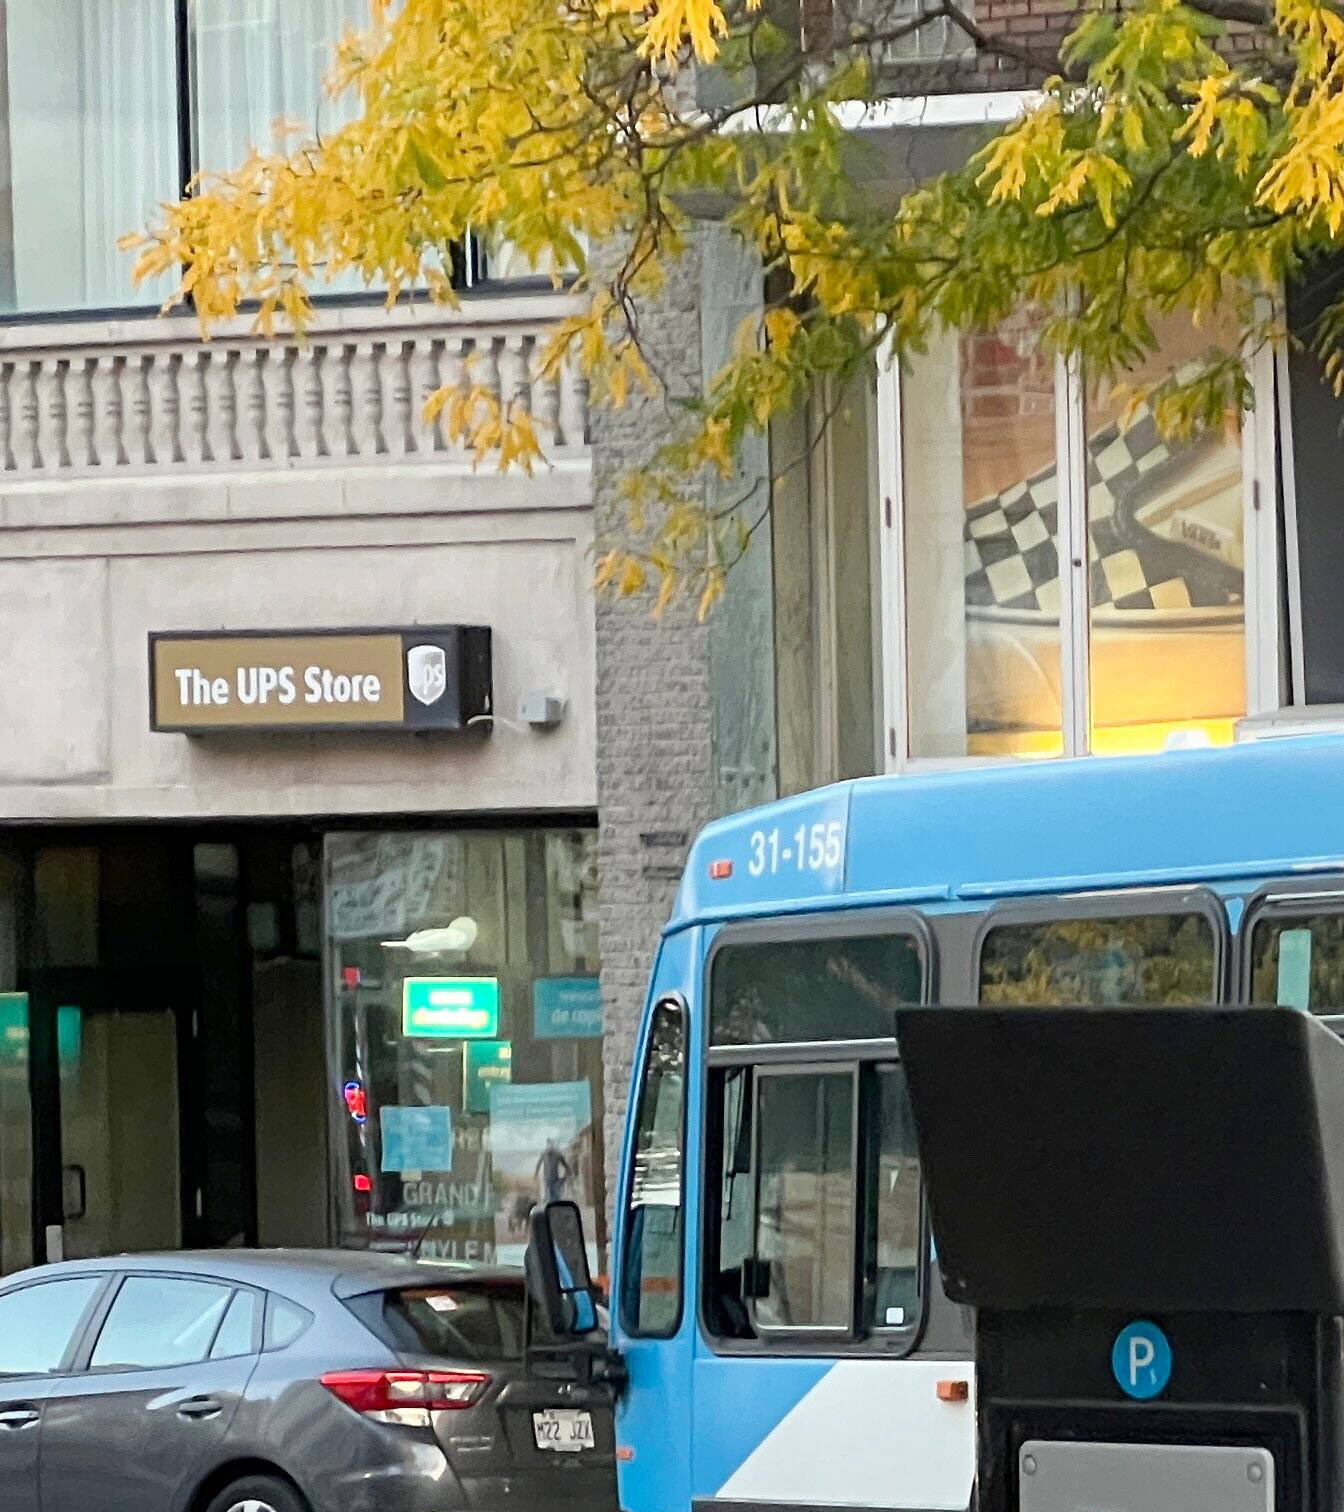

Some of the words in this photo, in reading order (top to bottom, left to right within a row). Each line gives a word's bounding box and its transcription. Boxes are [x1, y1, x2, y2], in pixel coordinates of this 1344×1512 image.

[175, 668, 229, 705] The
[237, 666, 296, 705] UPS
[304, 666, 382, 703] Store
[749, 822, 841, 876] 31-155
